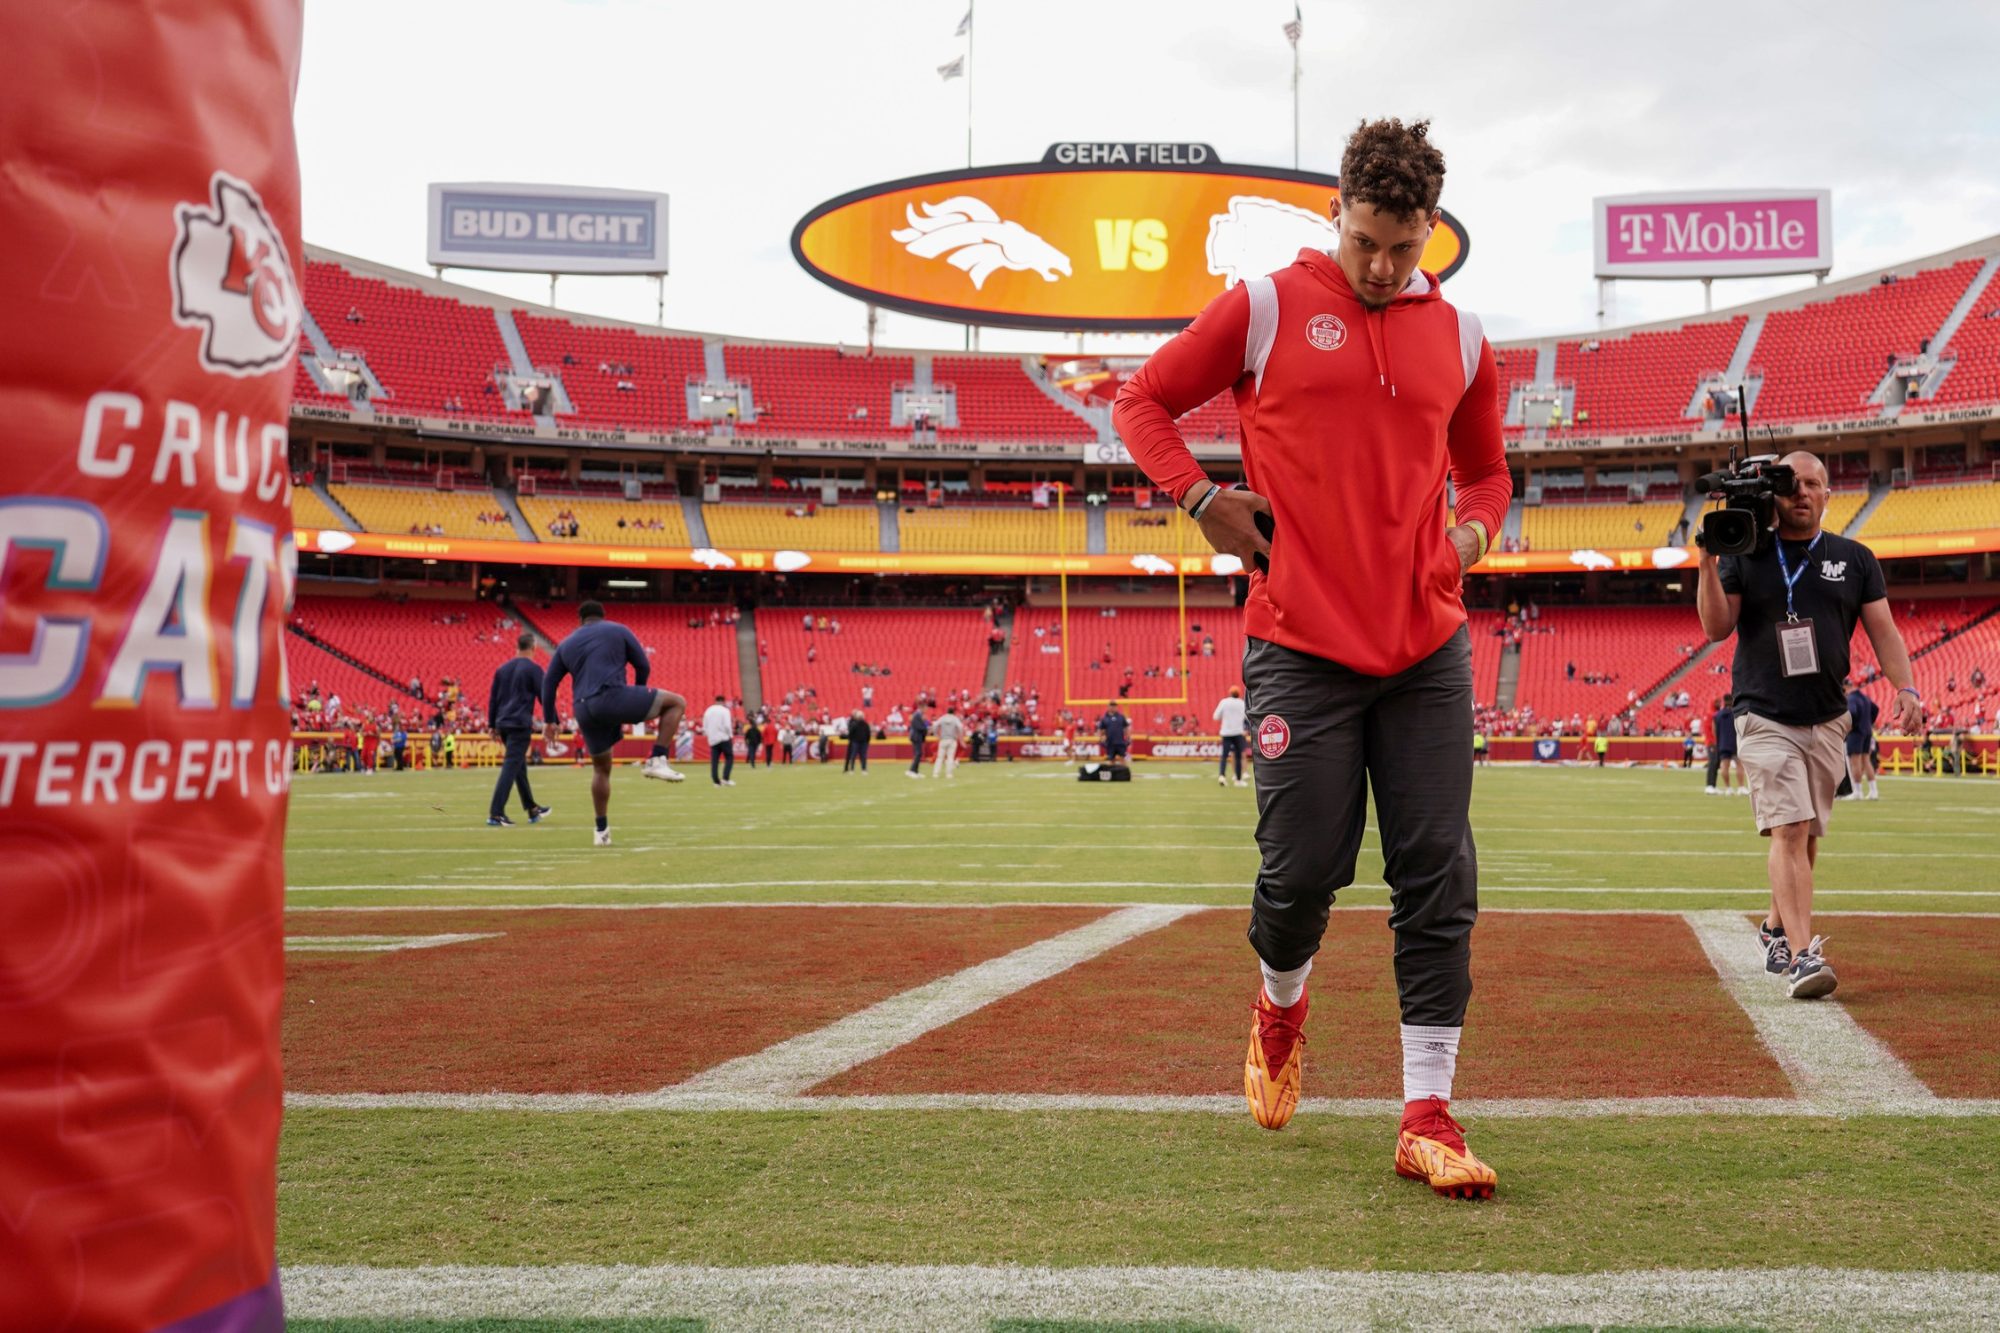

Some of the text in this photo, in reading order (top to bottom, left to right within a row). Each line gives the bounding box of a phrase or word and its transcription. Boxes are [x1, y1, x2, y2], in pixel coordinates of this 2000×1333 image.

[1055, 143, 1207, 164] GEHA FIELD
[453, 209, 644, 243] BUD LIGHT
[1662, 210, 1805, 253] Mobile
[1093, 218, 1168, 271] VS
[303, 408, 350, 420] DAWSON
[1949, 408, 1993, 420] RUDNAY
[399, 418, 423, 426] BELL
[1843, 417, 1899, 430] HEADRICK
[475, 424, 535, 436] BUCHANAN
[1736, 427, 1793, 438] SENERUD
[586, 432, 625, 441] TAYLOR
[1650, 434, 1692, 443] HAYNES
[757, 440, 797, 448] LANIER
[843, 442, 886, 450] THOMAS
[1025, 445, 1065, 453] WILSON
[1566, 438, 1601, 448] LYNCH
[1097, 443, 1129, 464] GE
[296, 531, 308, 548] S
[741, 552, 765, 568] VS
[1620, 551, 1643, 567] VS
[1822, 560, 1847, 577] TNF
[0, 739, 253, 807] TERCEPT
